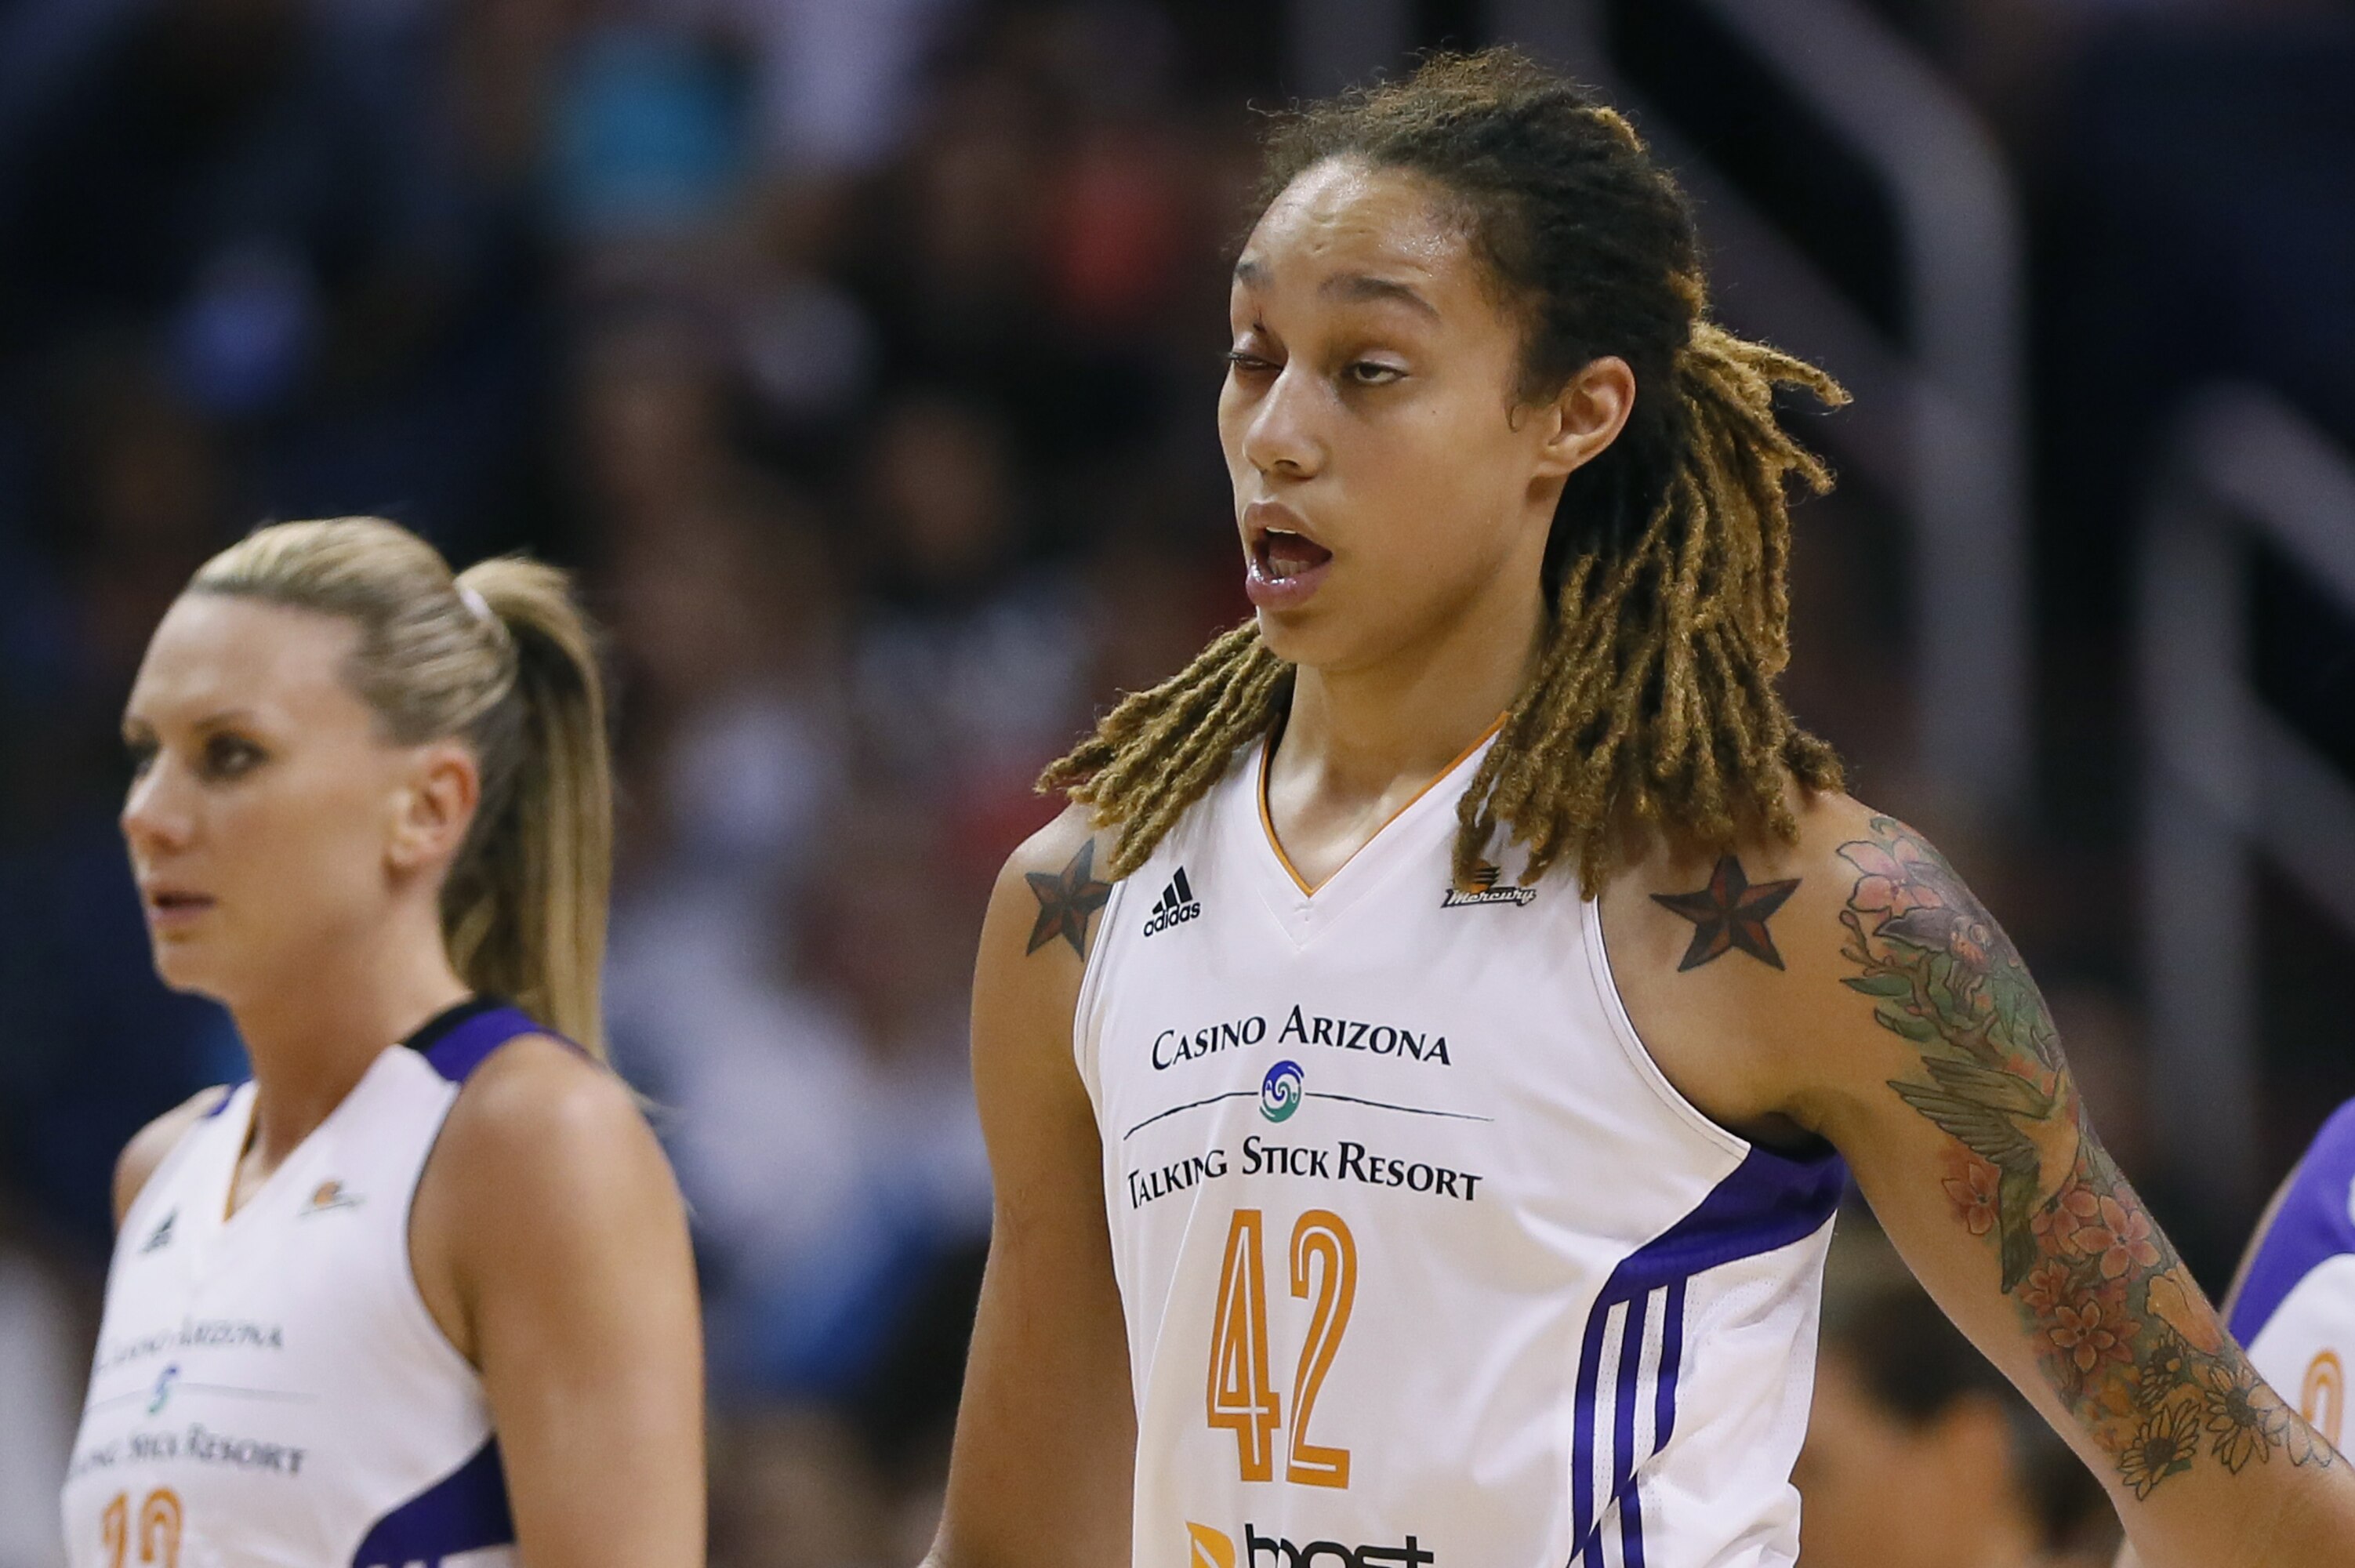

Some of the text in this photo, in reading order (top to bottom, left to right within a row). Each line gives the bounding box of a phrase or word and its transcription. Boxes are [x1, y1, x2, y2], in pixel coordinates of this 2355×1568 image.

[1143, 900, 1201, 937] adidas
[1442, 887, 1537, 906] Mercury
[1152, 1004, 1451, 1071] CASINO ARIZONA
[1127, 1135, 1483, 1210] TALKING STICK RESORT
[1207, 1210, 1358, 1490] 42
[1244, 1523, 1435, 1568] bost
